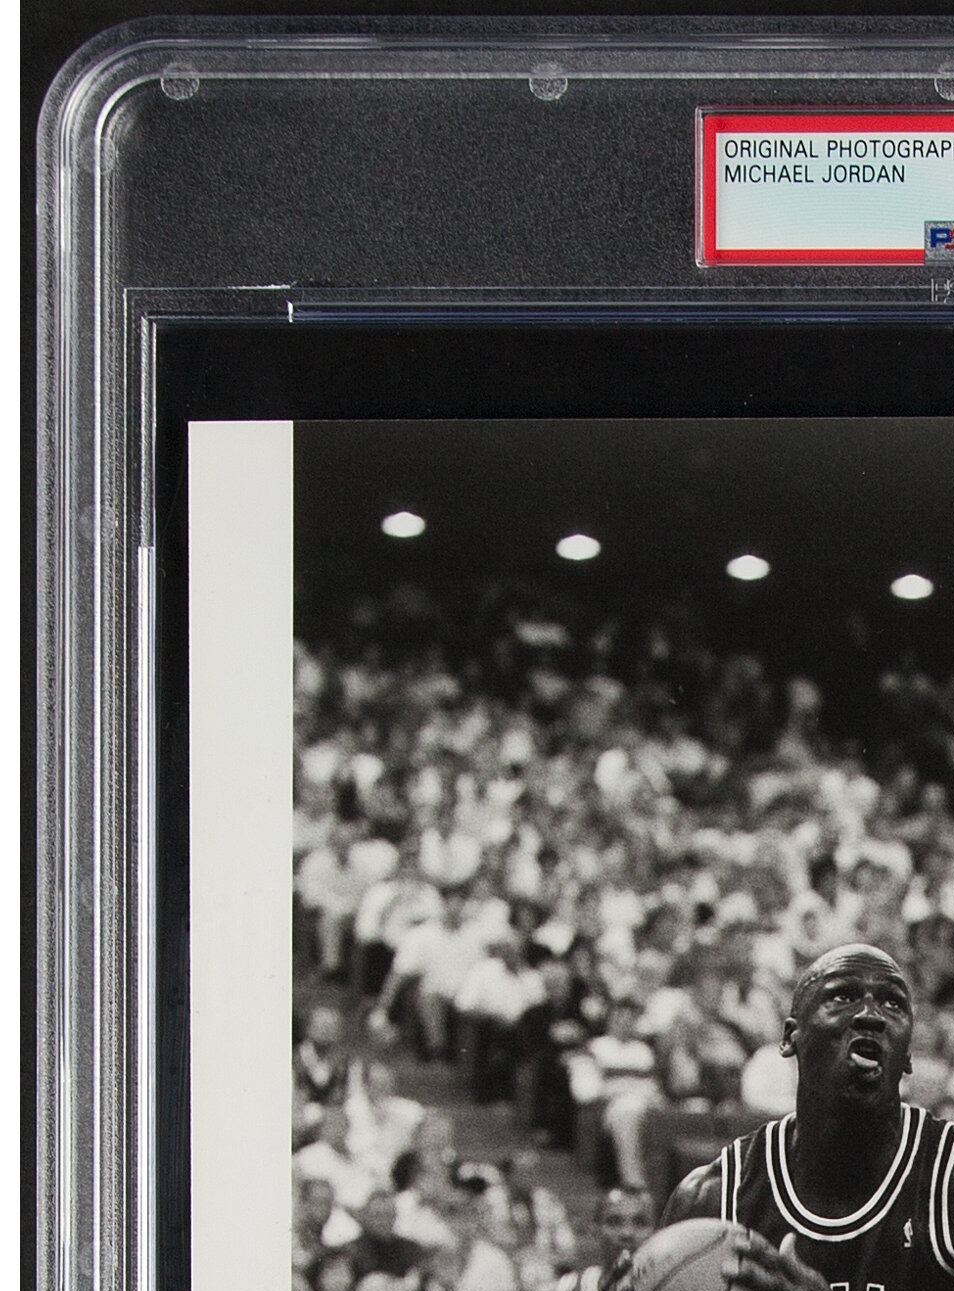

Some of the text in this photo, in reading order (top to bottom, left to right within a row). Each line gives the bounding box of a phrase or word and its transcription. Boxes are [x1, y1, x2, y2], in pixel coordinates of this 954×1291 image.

[724, 139, 819, 159] ORIGINAL
[724, 164, 905, 184] MICHAEL JORDAN
